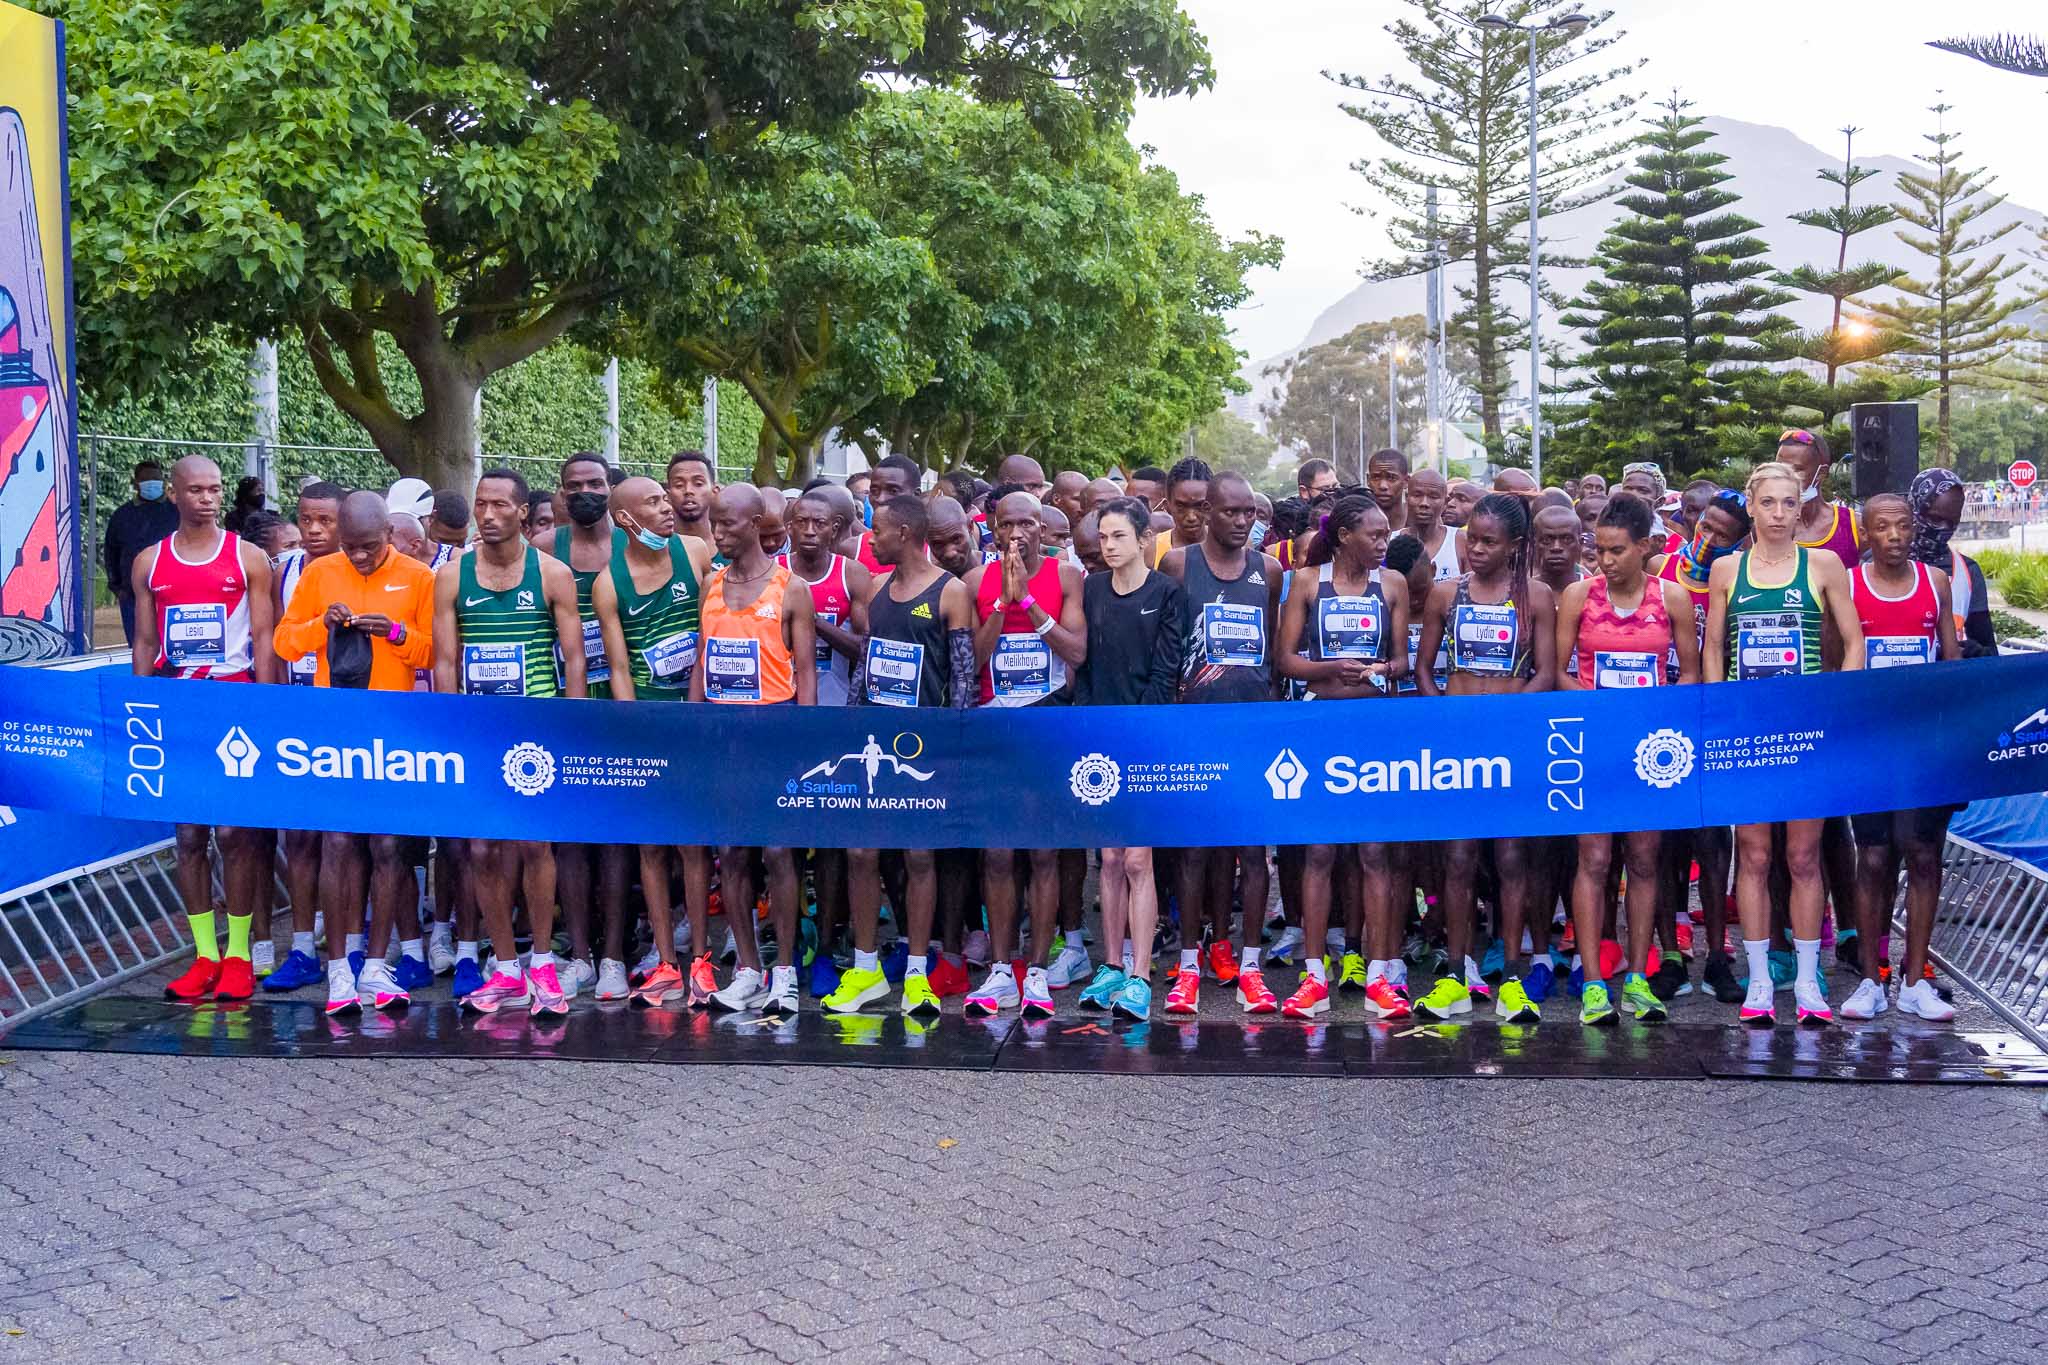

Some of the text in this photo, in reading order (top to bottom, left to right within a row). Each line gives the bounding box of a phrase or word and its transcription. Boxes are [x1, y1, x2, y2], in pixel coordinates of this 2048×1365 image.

[2011, 469, 2034, 480] STOP
[1340, 602, 1373, 611] Sanlam
[184, 611, 218, 619] Sanlam
[1224, 611, 1255, 621] Sanlam
[1475, 612, 1510, 622] Sanlam
[1343, 616, 1359, 630] Lucy
[1761, 618, 1776, 627] 2021
[1218, 624, 1252, 636] Emmanuel
[1476, 626, 1494, 640] Lydia
[662, 636, 694, 654] Sanlam
[1010, 640, 1042, 649] Sanlam
[1757, 636, 1792, 644] Sanlam
[720, 646, 750, 654] Sanlam
[882, 647, 914, 659] Sanlam
[1887, 643, 1921, 652] Sanlam
[480, 650, 516, 659] Sanlam
[1759, 650, 1780, 662] Gerda
[1616, 659, 1648, 668] Sanlam
[478, 664, 508, 678] Wubshet
[1619, 672, 1636, 686] Nurit
[4, 721, 93, 737] OF CAPE TOWN
[24, 734, 84, 748] SASEKAPA
[1704, 730, 1824, 748] CITY OF CAPE TOWN
[5, 743, 68, 758] KAAPSTAD
[125, 702, 165, 798] 2021
[1704, 742, 1815, 760] ISIXEKO SASEKAPA
[1988, 746, 2026, 762] CAPE
[276, 738, 466, 785] Sanlam
[562, 756, 668, 768] CITY OF CAPE TOWN
[1128, 762, 1229, 772] CITY OF CAPE TOWN
[1547, 715, 1584, 812] 2021
[1704, 756, 1799, 771] STAD KAAPSTAD
[562, 766, 660, 777] ISIXEKO SASEKAPA
[1128, 773, 1222, 782] ISIXEKO SASEKAPA
[1324, 748, 1512, 795] Sanlam
[562, 776, 646, 787] STAD KAAPSTAD
[802, 780, 858, 794] Sanlam
[1128, 783, 1208, 792] STAD KAAPSTAD
[776, 796, 947, 810] CAPE TOWN MARATHON
